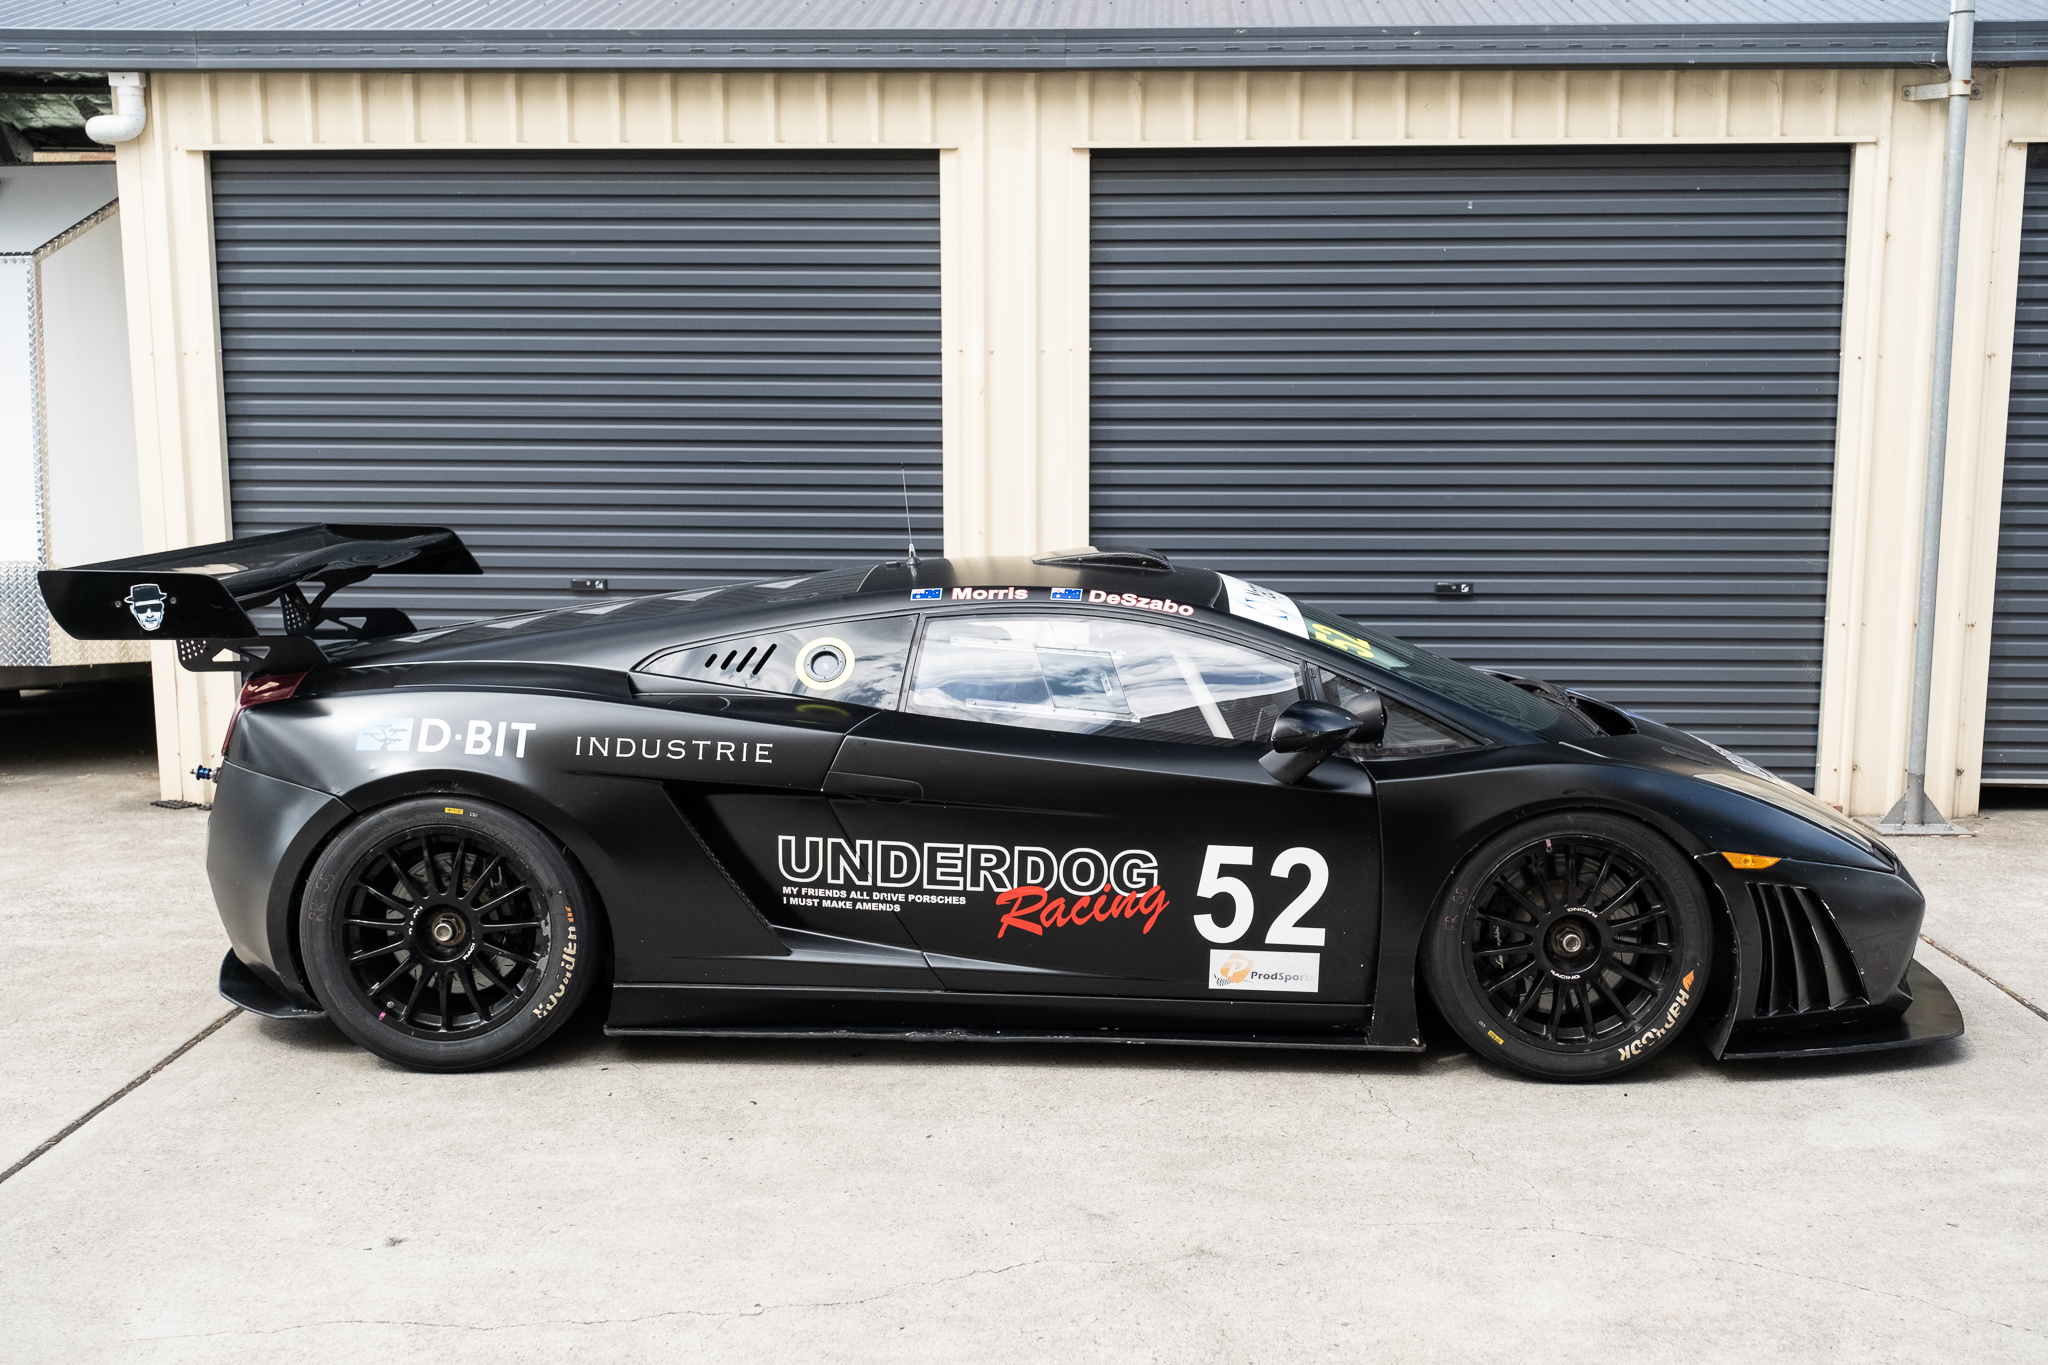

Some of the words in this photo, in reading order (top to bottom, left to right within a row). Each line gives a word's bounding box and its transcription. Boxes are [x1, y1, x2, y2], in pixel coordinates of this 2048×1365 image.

[951, 587, 1029, 601] Morris
[1088, 590, 1194, 616] DeSzabo
[574, 735, 774, 764] INDUSTRIE
[778, 835, 1159, 898] UNDERDOG
[782, 886, 799, 895] MY
[802, 888, 847, 898] FRIENDS
[850, 891, 870, 900] ALL
[873, 892, 906, 902] DRIVE
[908, 894, 967, 905] PORSCHES
[790, 897, 818, 906] MUST
[822, 900, 853, 909] MAKE
[856, 903, 901, 912] AMENDS
[1193, 844, 1329, 946] 52
[996, 883, 1170, 938] Racing
[1250, 971, 1315, 982] ProdSports
